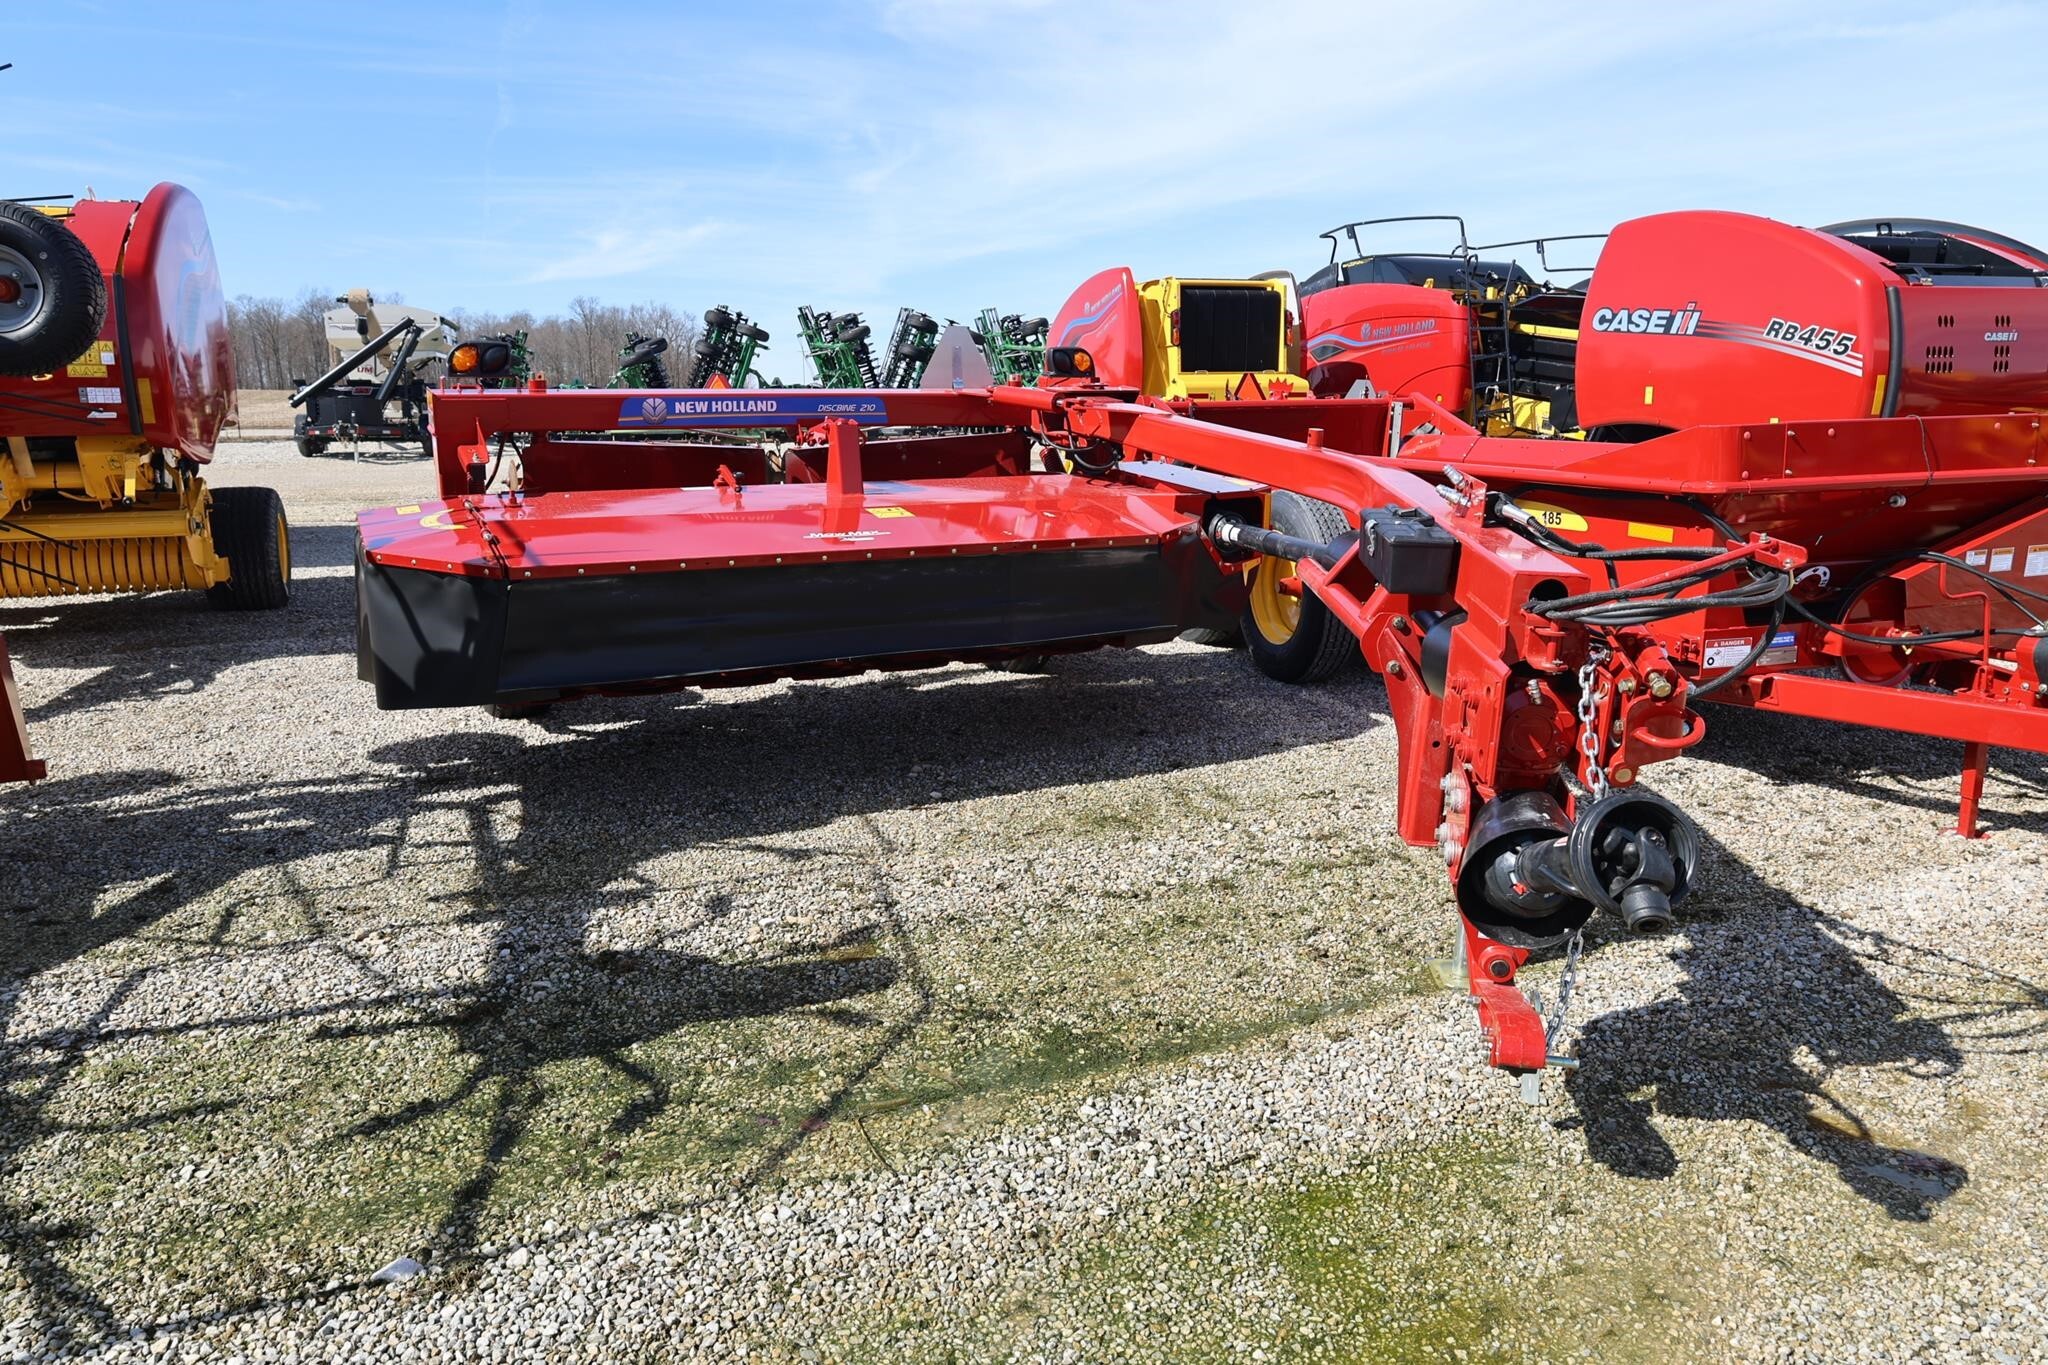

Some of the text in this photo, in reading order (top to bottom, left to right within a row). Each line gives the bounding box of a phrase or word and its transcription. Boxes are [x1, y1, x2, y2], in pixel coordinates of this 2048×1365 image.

[1592, 308, 1671, 334] CASE
[1373, 319, 1435, 339] NEW HOLLAND
[1984, 331, 2009, 341] CASE
[1763, 317, 1857, 356] RB455
[674, 400, 778, 413] NEW HOLLAND
[817, 403, 876, 412] DISCBINE 210
[1541, 511, 1562, 526] 185
[1720, 639, 1745, 647] DANGER
